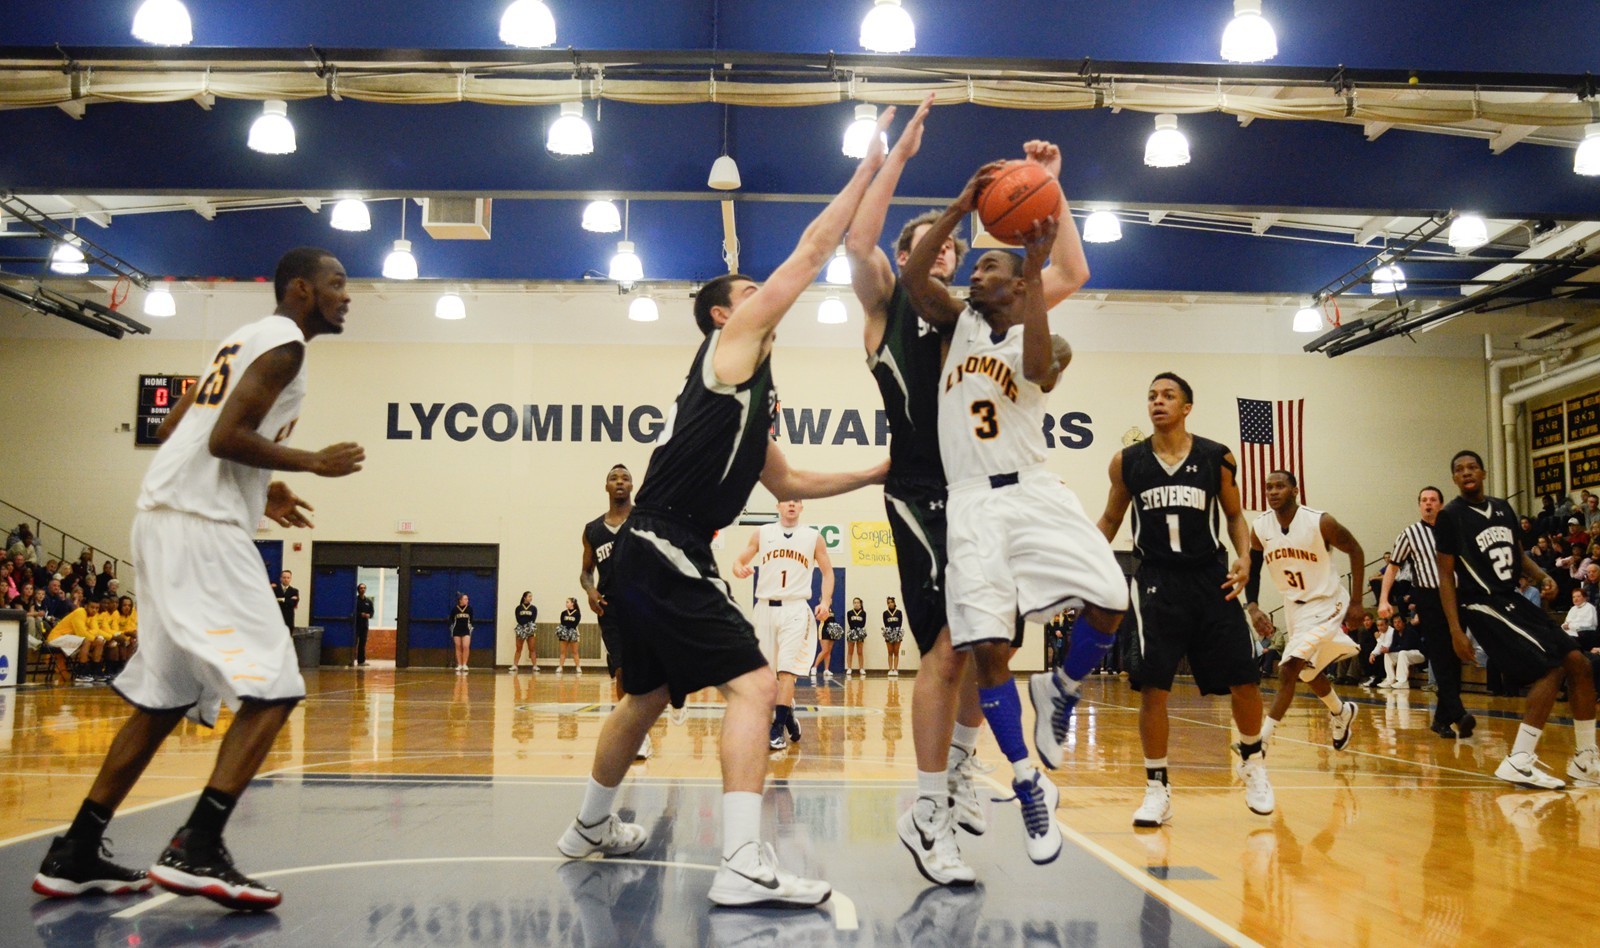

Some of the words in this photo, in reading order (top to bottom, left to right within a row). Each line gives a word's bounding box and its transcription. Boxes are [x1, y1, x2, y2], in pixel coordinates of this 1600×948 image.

[144, 377, 168, 386] HOME
[155, 387, 168, 407] 0
[386, 402, 666, 444] LYCOMING
[970, 399, 999, 440] 3
[1139, 485, 1207, 512] STEVENSON
[1165, 513, 1182, 553] 1
[762, 548, 809, 570] LYCOMING
[780, 569, 788, 588] 1
[1283, 569, 1306, 591] 31
